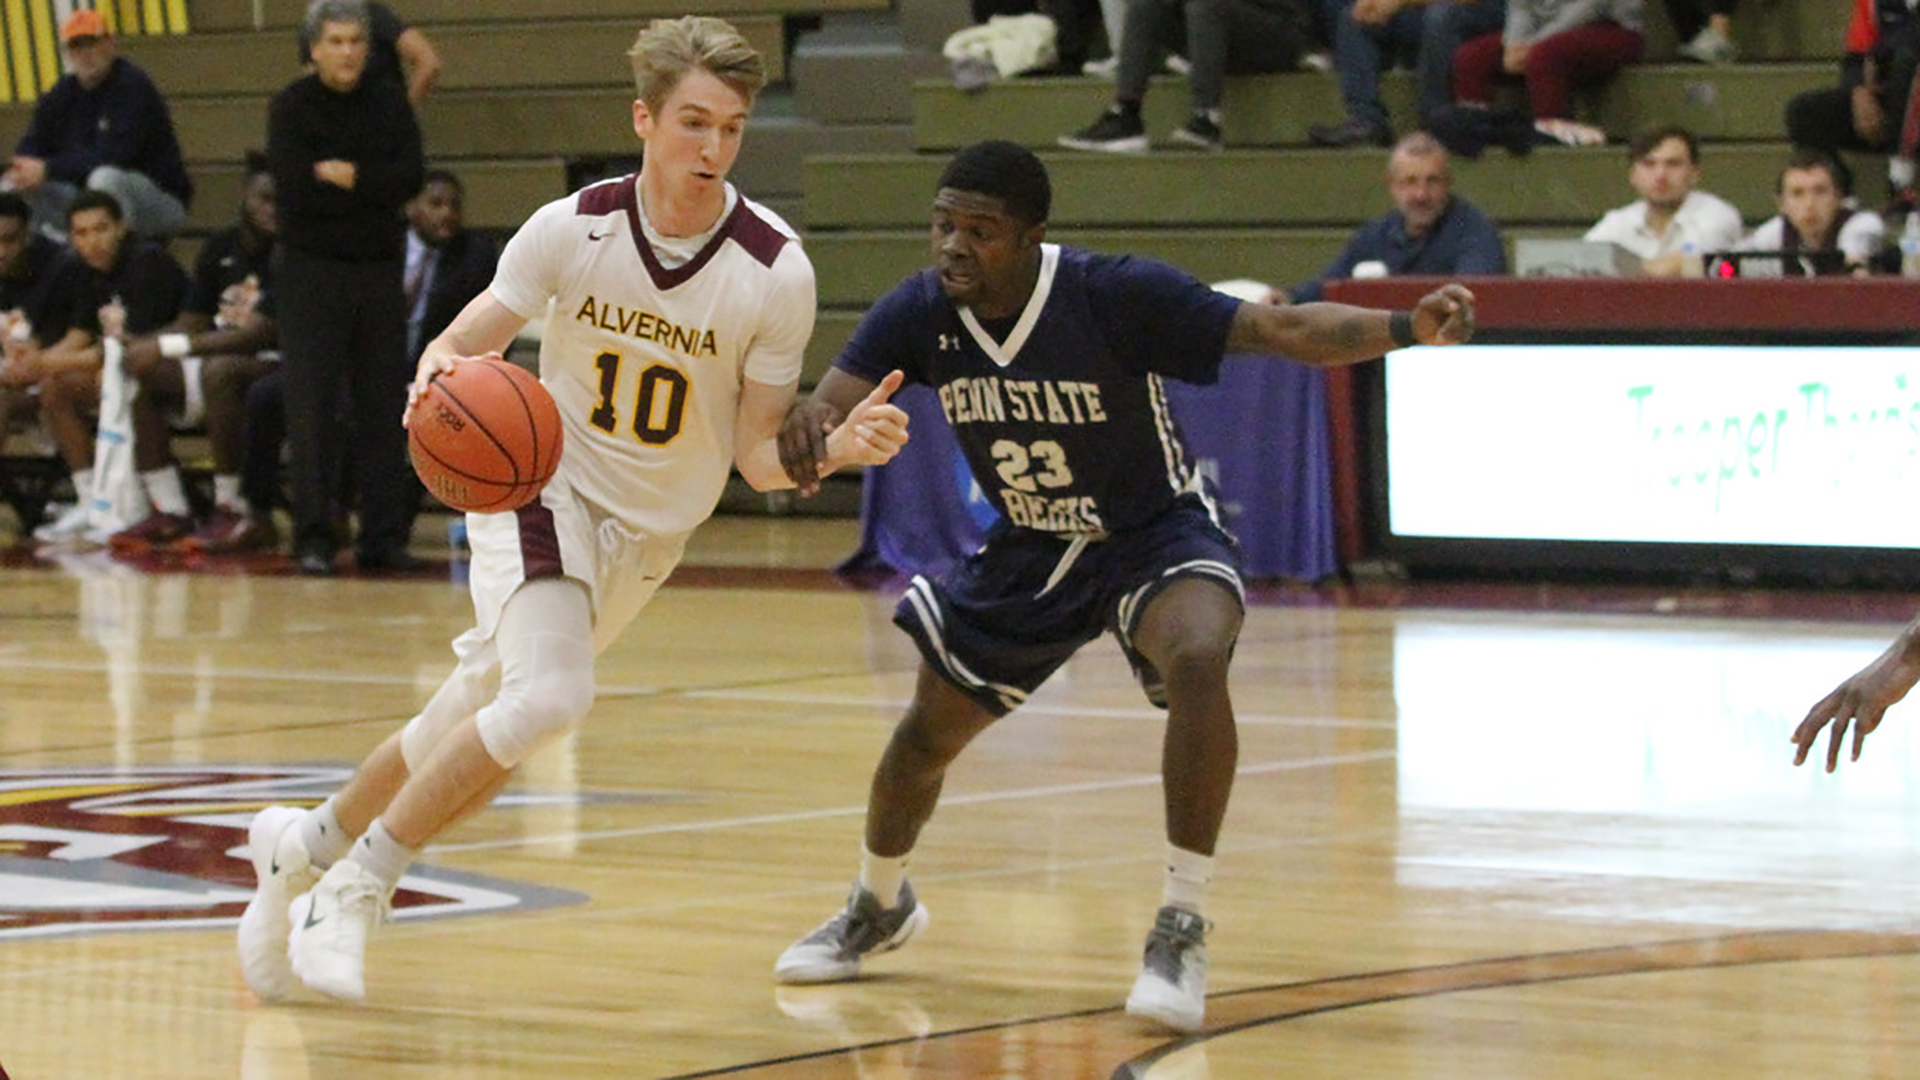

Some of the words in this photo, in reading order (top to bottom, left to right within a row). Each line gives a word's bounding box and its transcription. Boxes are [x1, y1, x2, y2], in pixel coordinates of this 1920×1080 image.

[574, 294, 718, 356] ALVERNIA
[588, 351, 691, 448] 10
[938, 376, 1006, 424] PENN
[1003, 379, 1108, 425] STATE
[989, 438, 1075, 492] 23
[1000, 488, 1103, 532] BERKS
